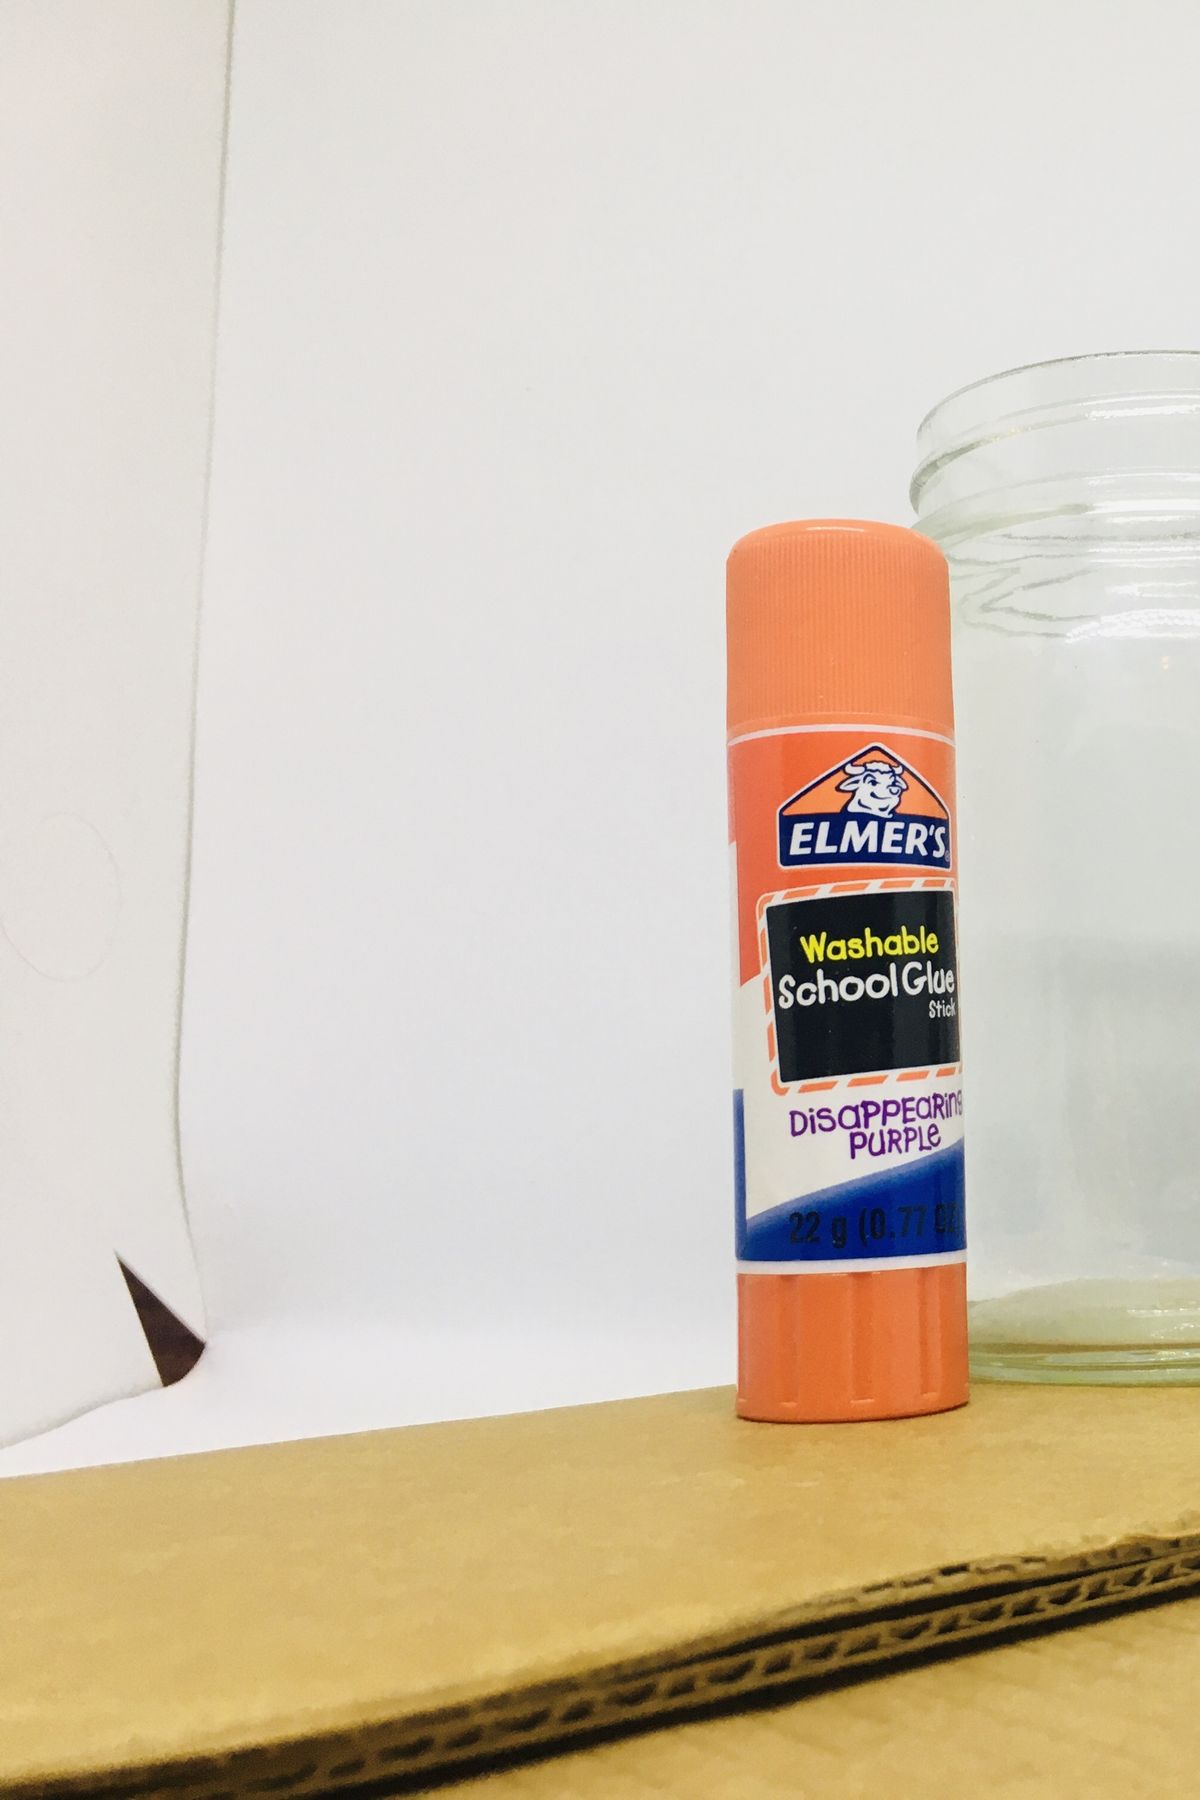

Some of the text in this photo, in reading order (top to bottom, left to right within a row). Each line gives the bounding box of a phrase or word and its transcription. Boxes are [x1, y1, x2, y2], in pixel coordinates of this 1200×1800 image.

[789, 820, 947, 858] ELMER'S
[800, 926, 939, 963] Washable
[778, 960, 955, 1009] School Glue
[928, 998, 955, 1019] Stick
[789, 1211, 822, 1243] 22
[831, 1215, 848, 1248] g
[858, 1203, 929, 1248] (0.77
